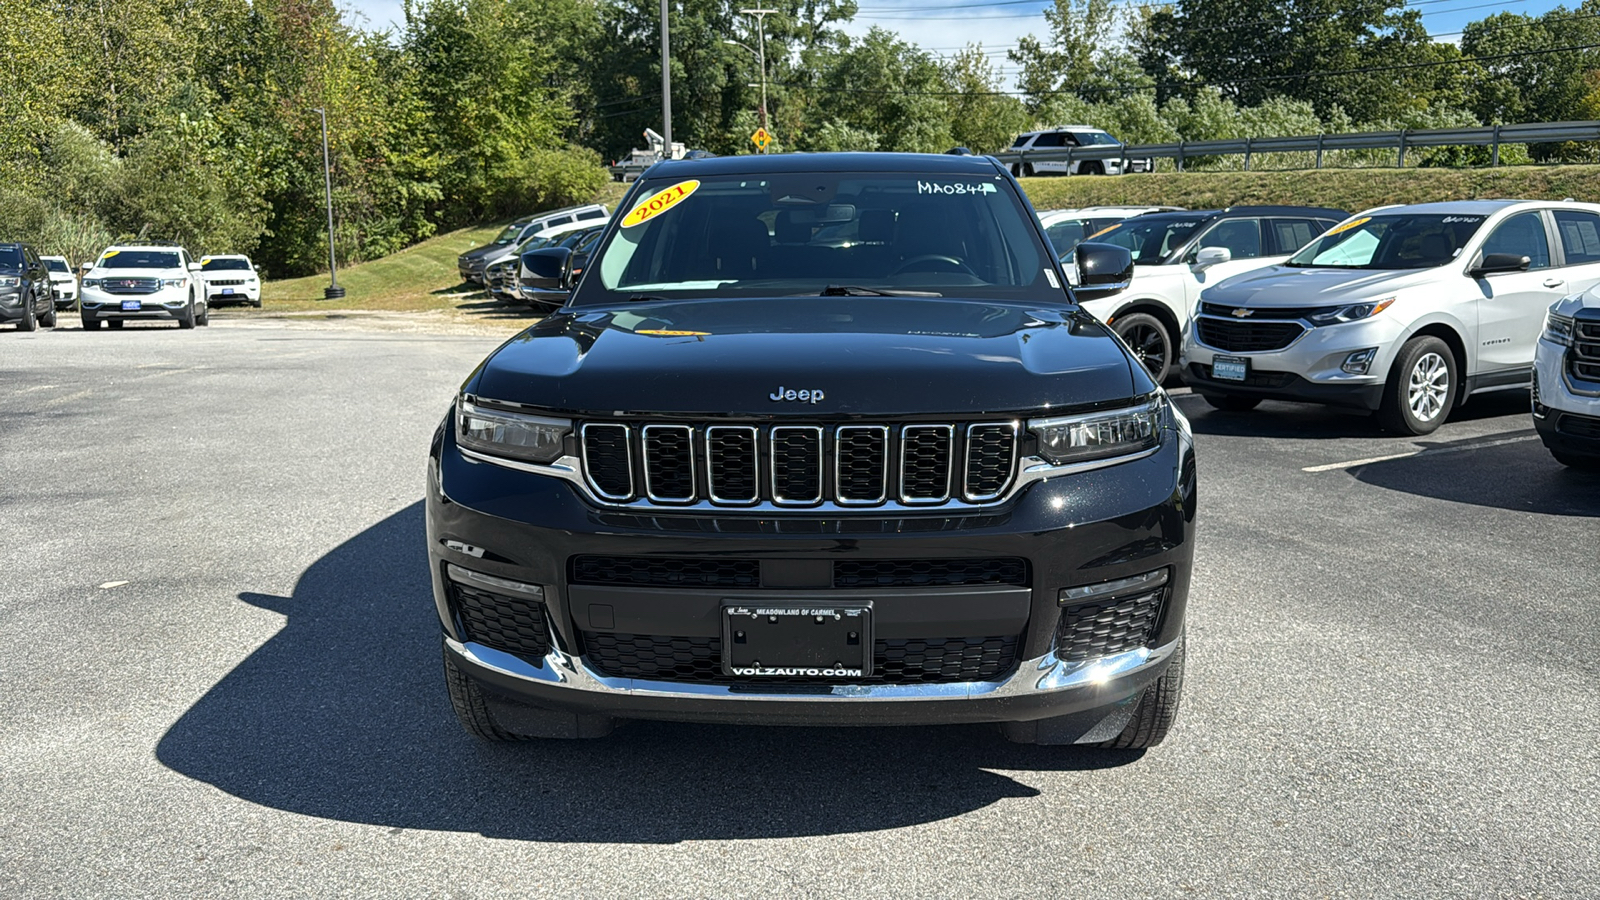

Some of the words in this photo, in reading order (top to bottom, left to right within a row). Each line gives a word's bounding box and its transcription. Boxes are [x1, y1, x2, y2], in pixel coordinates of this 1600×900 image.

[636, 186, 688, 220] 2021
[1214, 363, 1246, 373] CERTIFIED
[769, 386, 825, 404] Jeep
[756, 608, 800, 616] MEADOWLAND
[801, 608, 810, 616] OF
[810, 608, 836, 616] CARMEL
[732, 667, 862, 677] VOLZAUTO.COM
